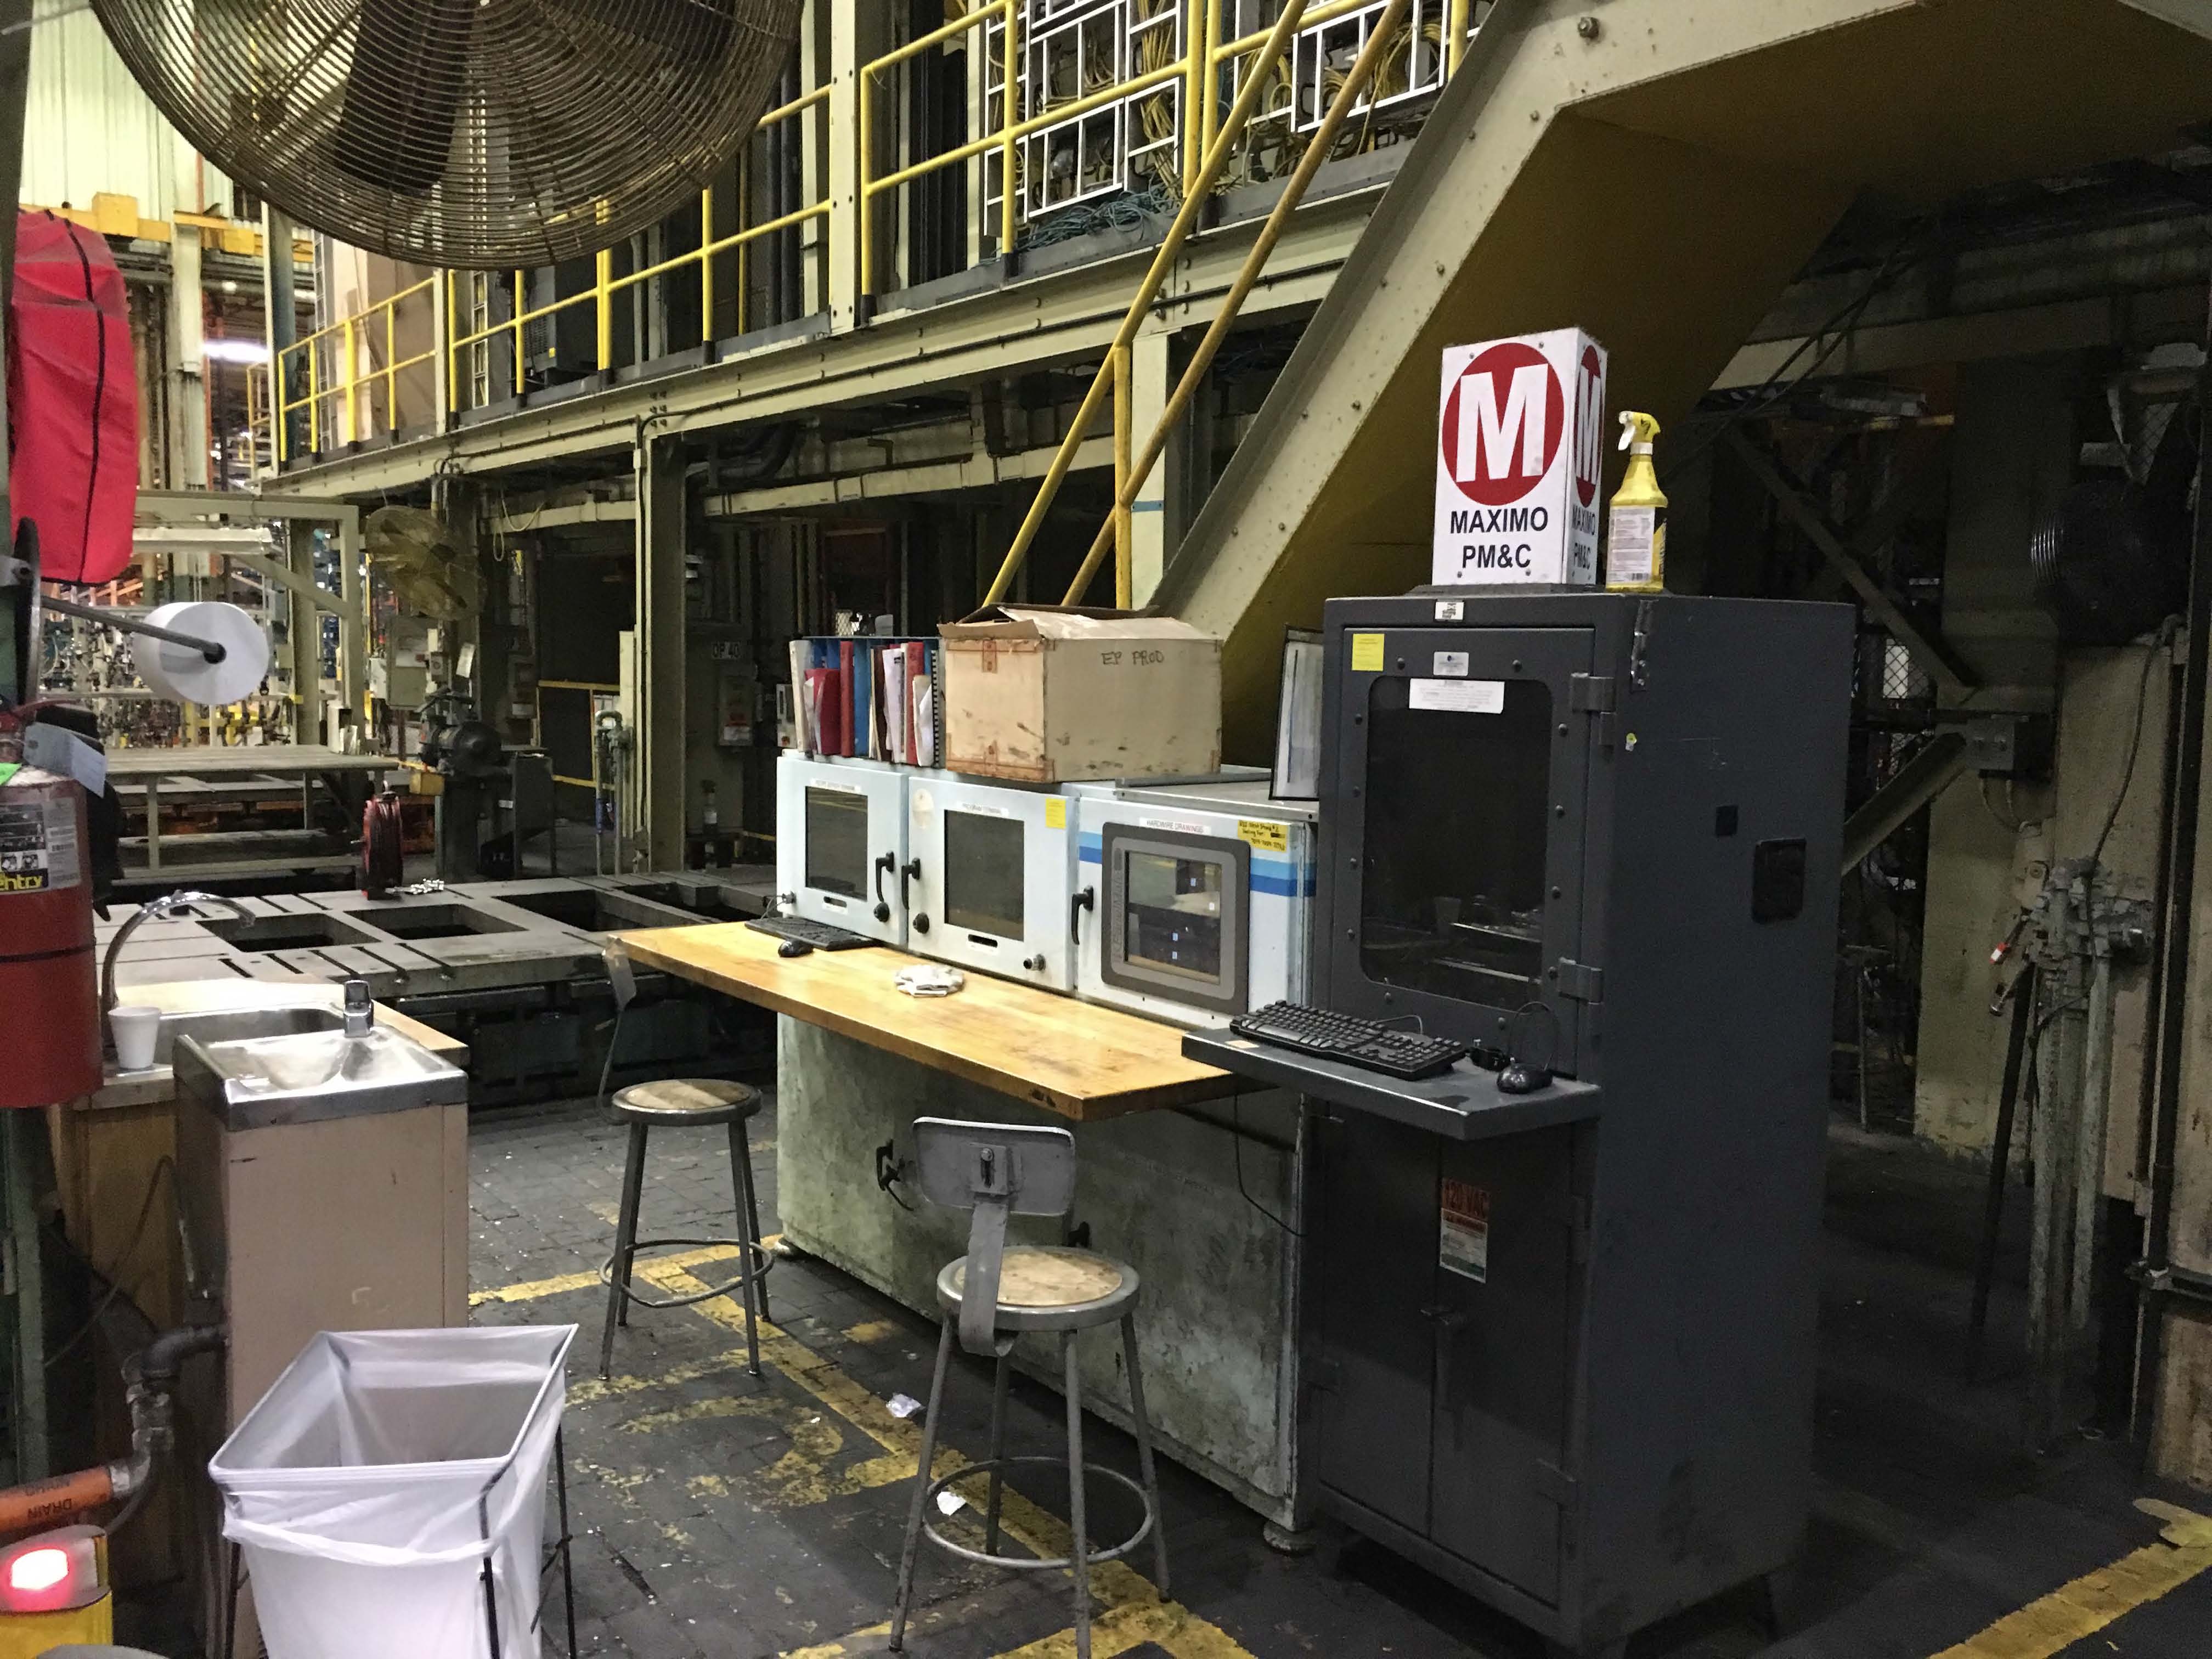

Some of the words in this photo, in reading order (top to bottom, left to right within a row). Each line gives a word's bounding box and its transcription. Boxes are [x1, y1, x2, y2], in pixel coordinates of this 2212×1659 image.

[1455, 363, 1548, 483] M
[1576, 365, 1601, 485] M
[1450, 507, 1548, 534] MAXIMO
[1572, 505, 1595, 535] MAXIMO
[1462, 544, 1532, 568] PM&C
[1101, 651, 1122, 665] EP
[1132, 650, 1164, 665] PROD
